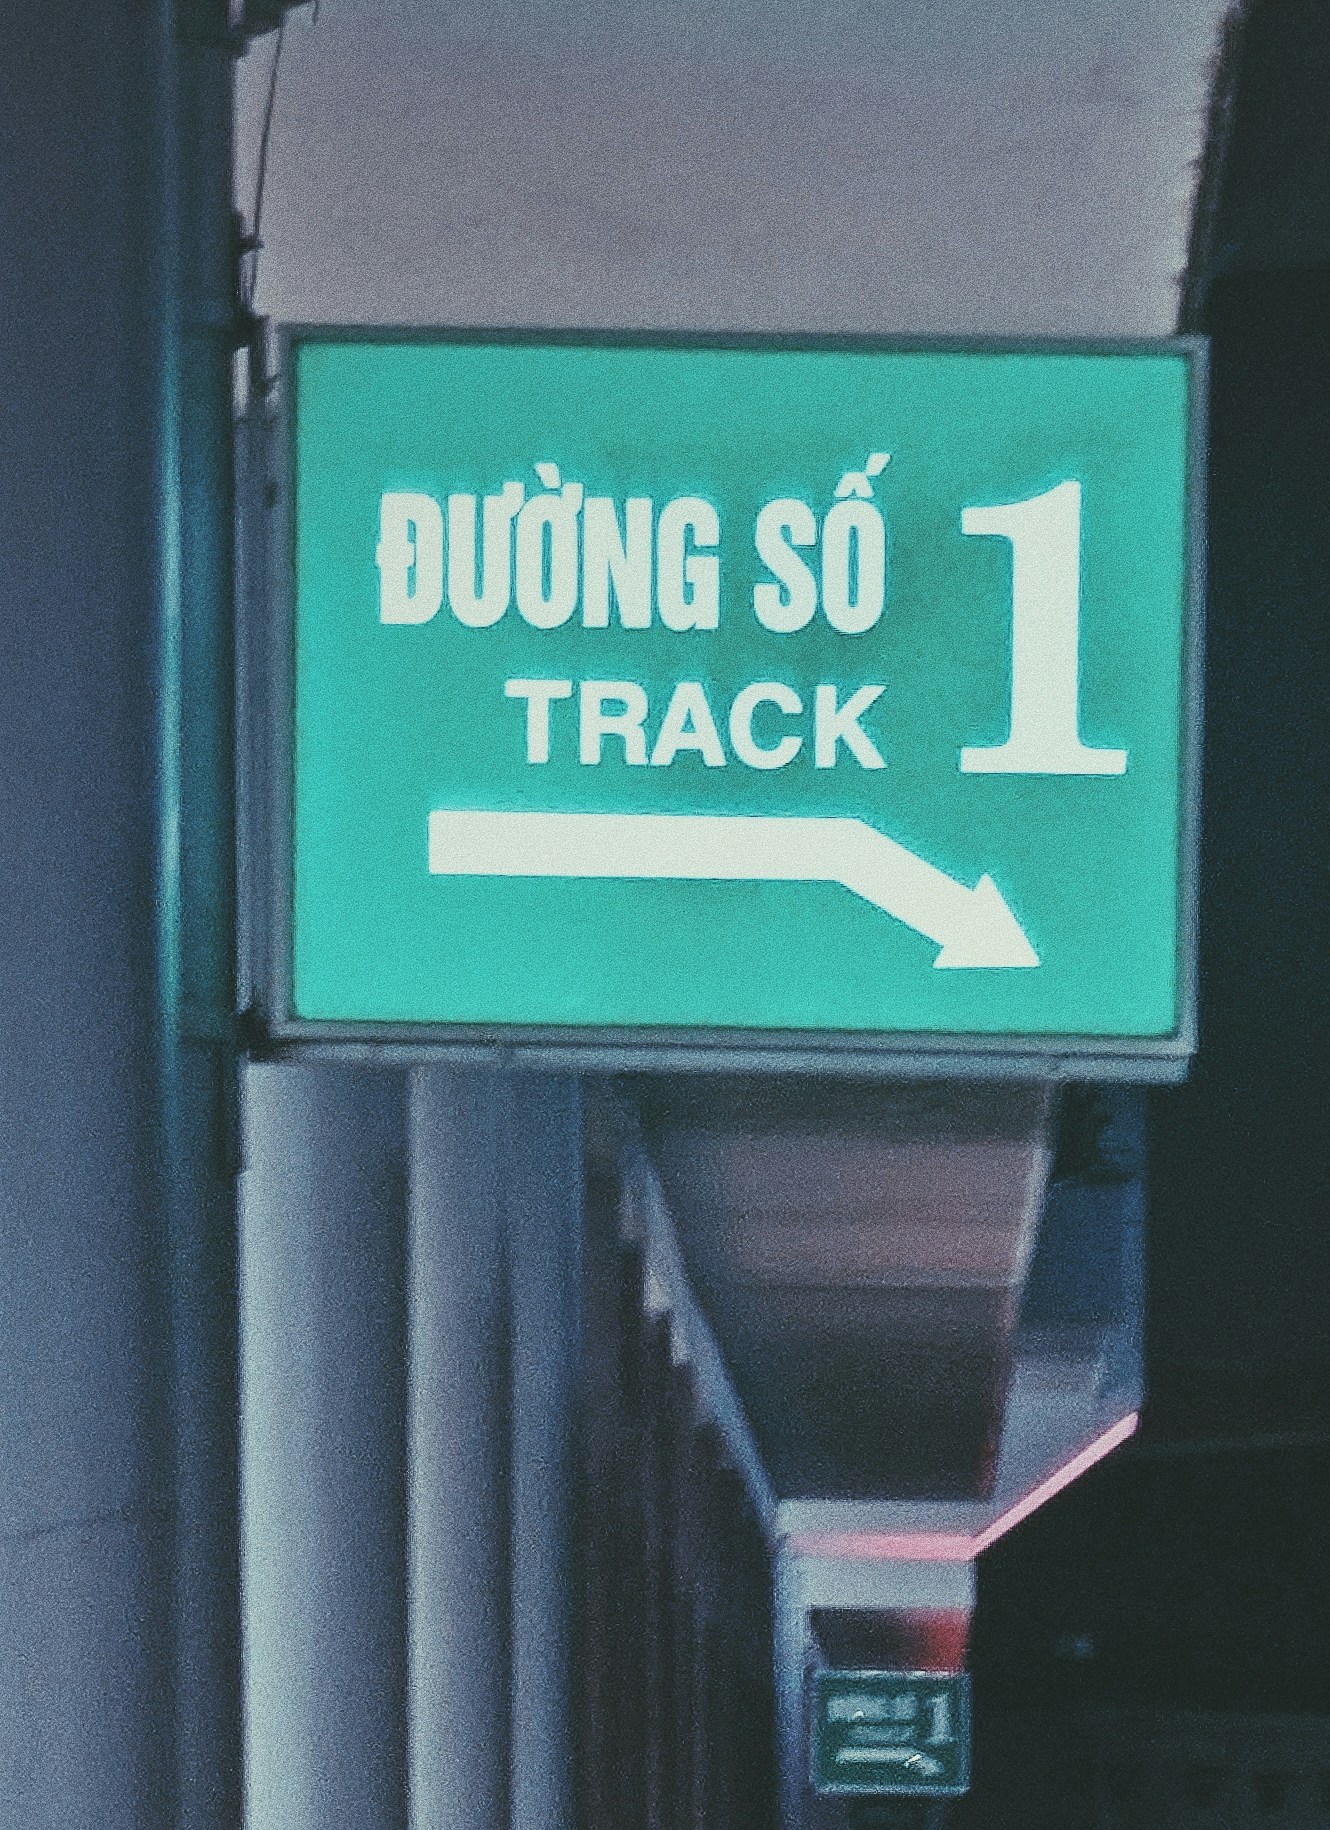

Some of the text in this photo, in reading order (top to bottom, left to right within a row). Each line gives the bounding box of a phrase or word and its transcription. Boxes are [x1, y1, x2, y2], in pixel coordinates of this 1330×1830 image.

[375, 453, 891, 634] ĐƯỜNG SỐ
[960, 480, 1129, 775] 1
[504, 679, 888, 769] TRACK
[924, 1692, 958, 1746] 1
